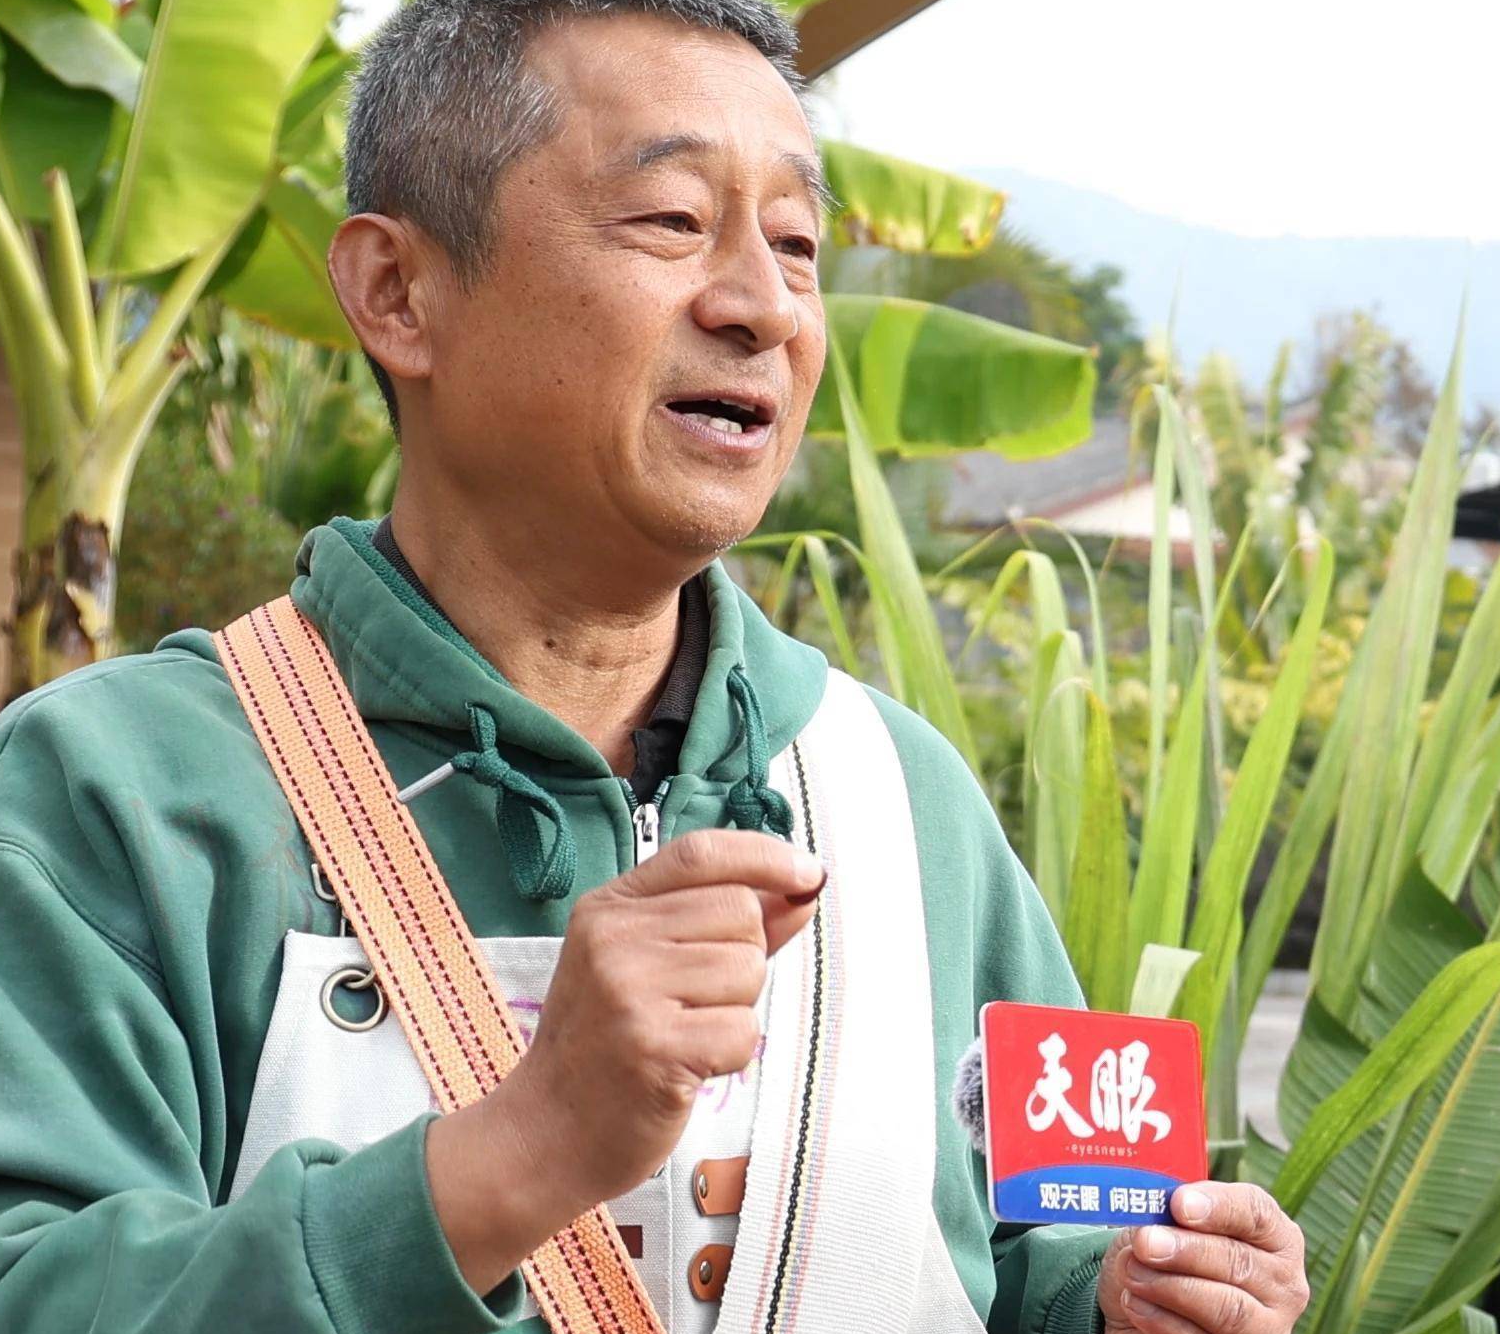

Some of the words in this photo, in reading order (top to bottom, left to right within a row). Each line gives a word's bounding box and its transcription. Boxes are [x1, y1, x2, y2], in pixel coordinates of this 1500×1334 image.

[1025, 1032, 1172, 1144] 天眼
[1039, 1183, 1100, 1212] 观天眼
